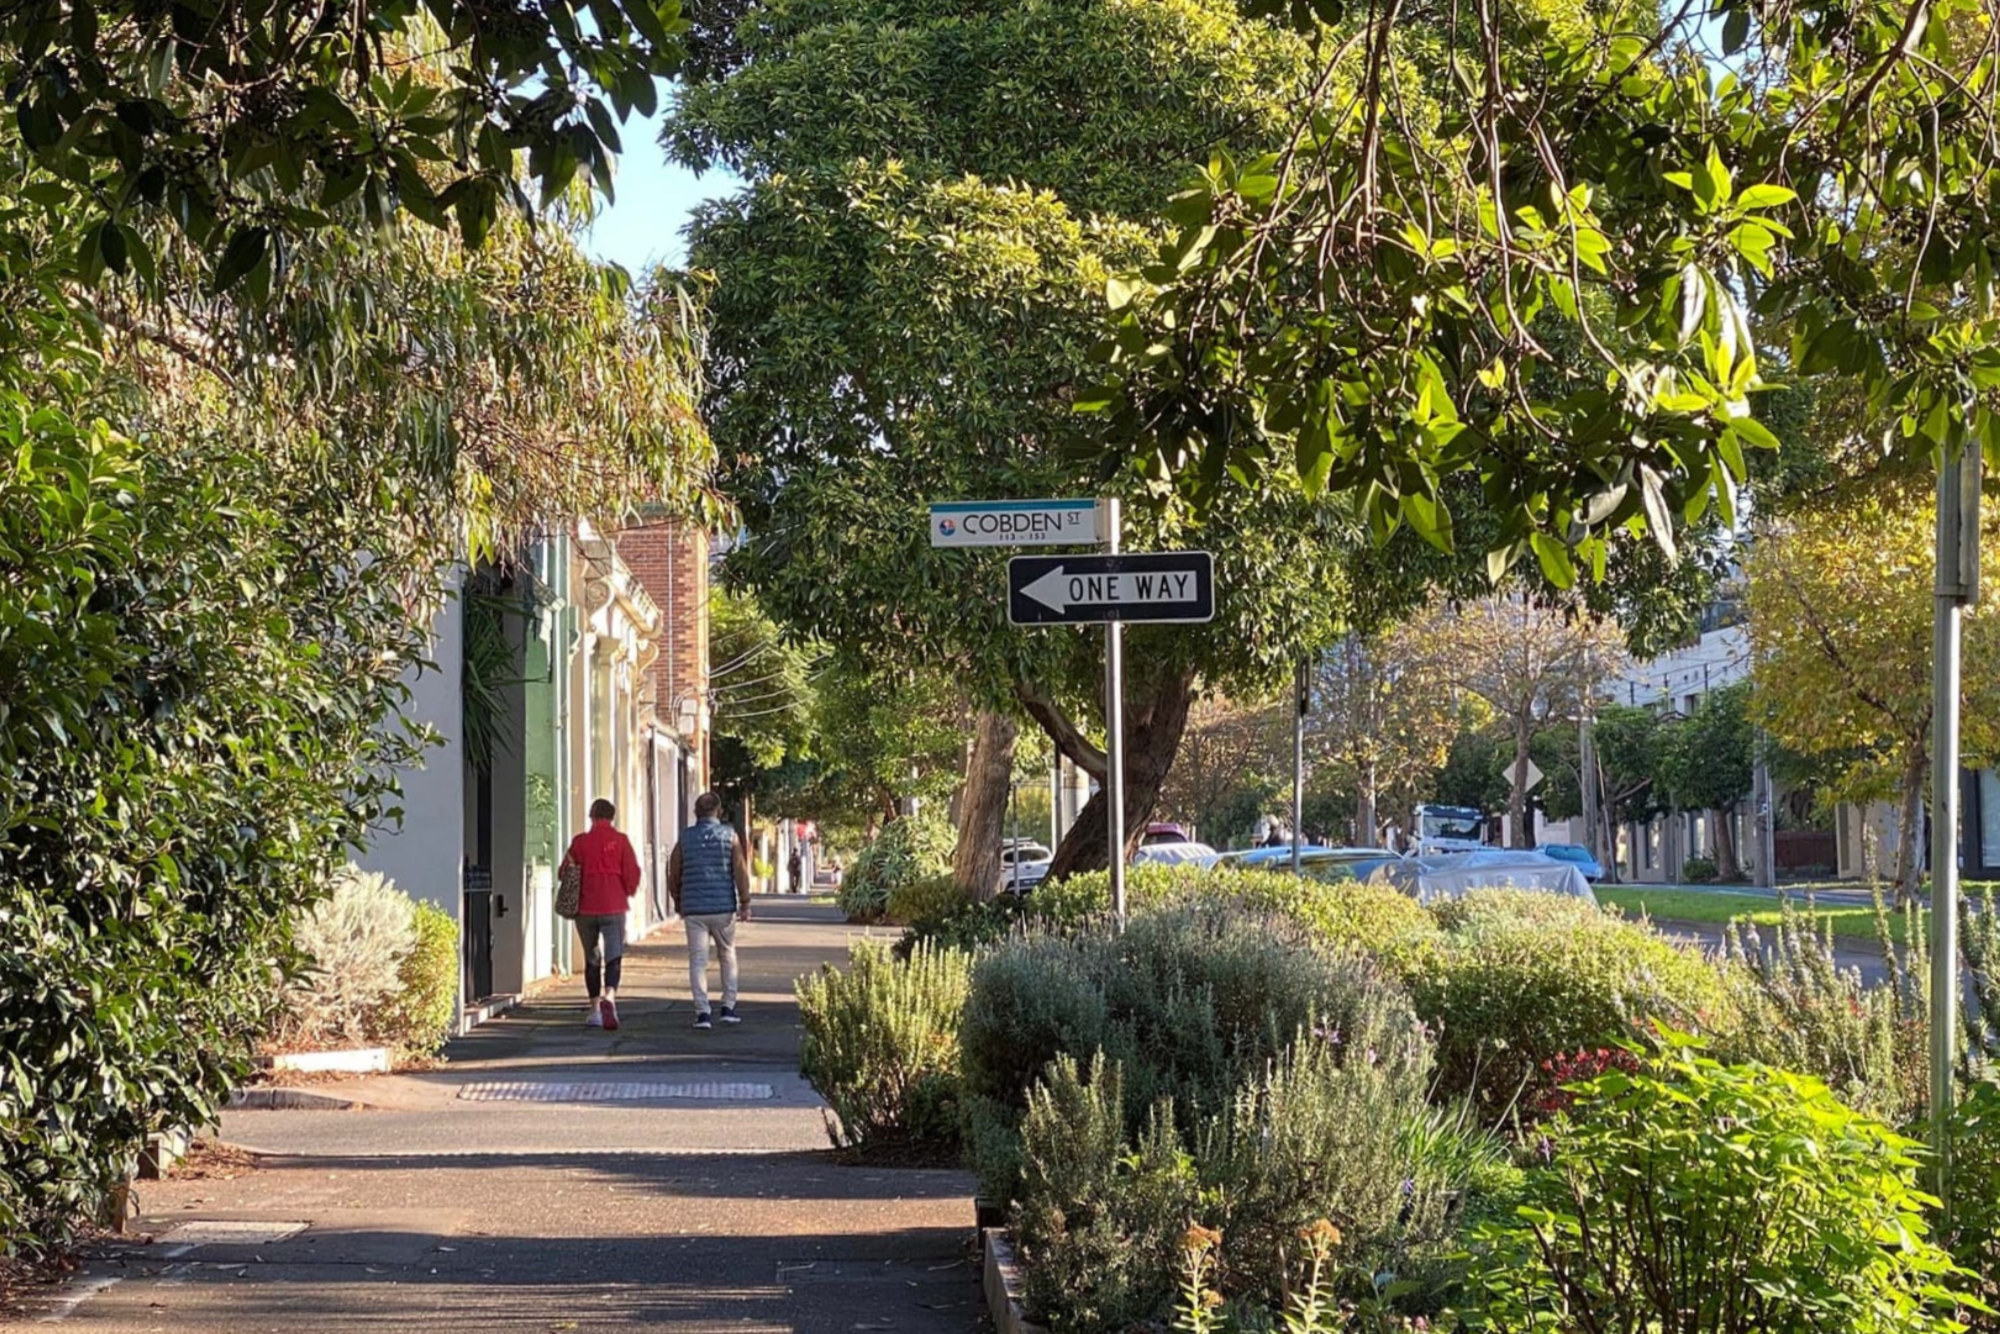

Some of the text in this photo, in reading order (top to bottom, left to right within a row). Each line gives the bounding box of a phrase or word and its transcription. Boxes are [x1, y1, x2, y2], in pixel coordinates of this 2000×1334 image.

[963, 511, 1081, 534] COBDEN ST
[1029, 532, 1046, 540] 153
[1069, 574, 1188, 602] ONE WAY
